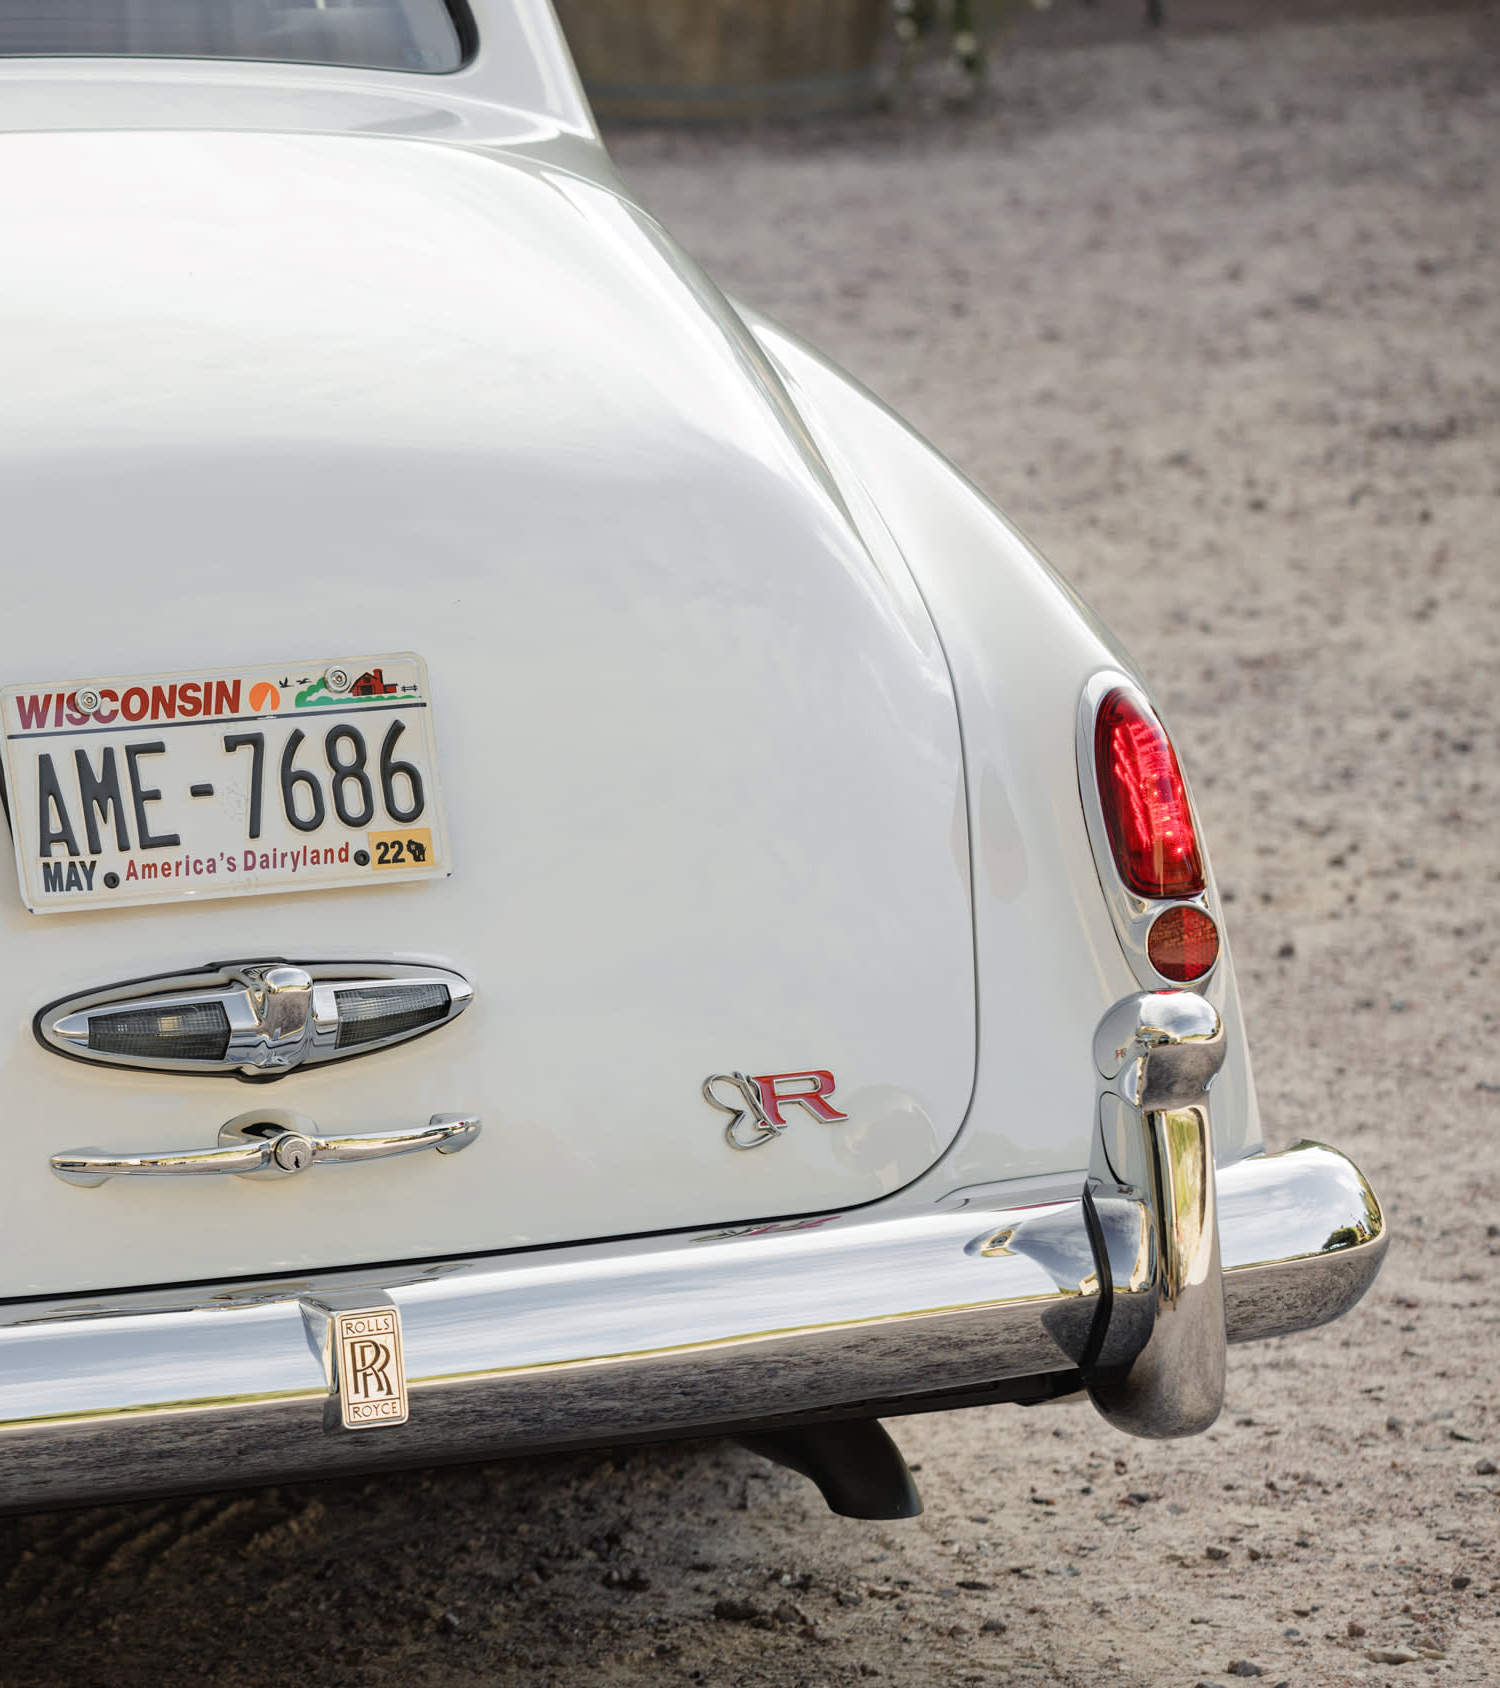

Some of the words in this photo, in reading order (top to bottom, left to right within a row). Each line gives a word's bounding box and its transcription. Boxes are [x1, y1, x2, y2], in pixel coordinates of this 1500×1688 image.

[15, 680, 241, 729] WISCONSIN
[125, 852, 237, 881] America's
[243, 842, 349, 873] Dairyland
[375, 840, 406, 865] 22
[42, 860, 97, 892] MAY
[345, 1318, 390, 1335] ROLLS
[352, 1402, 398, 1419] ROYCE
